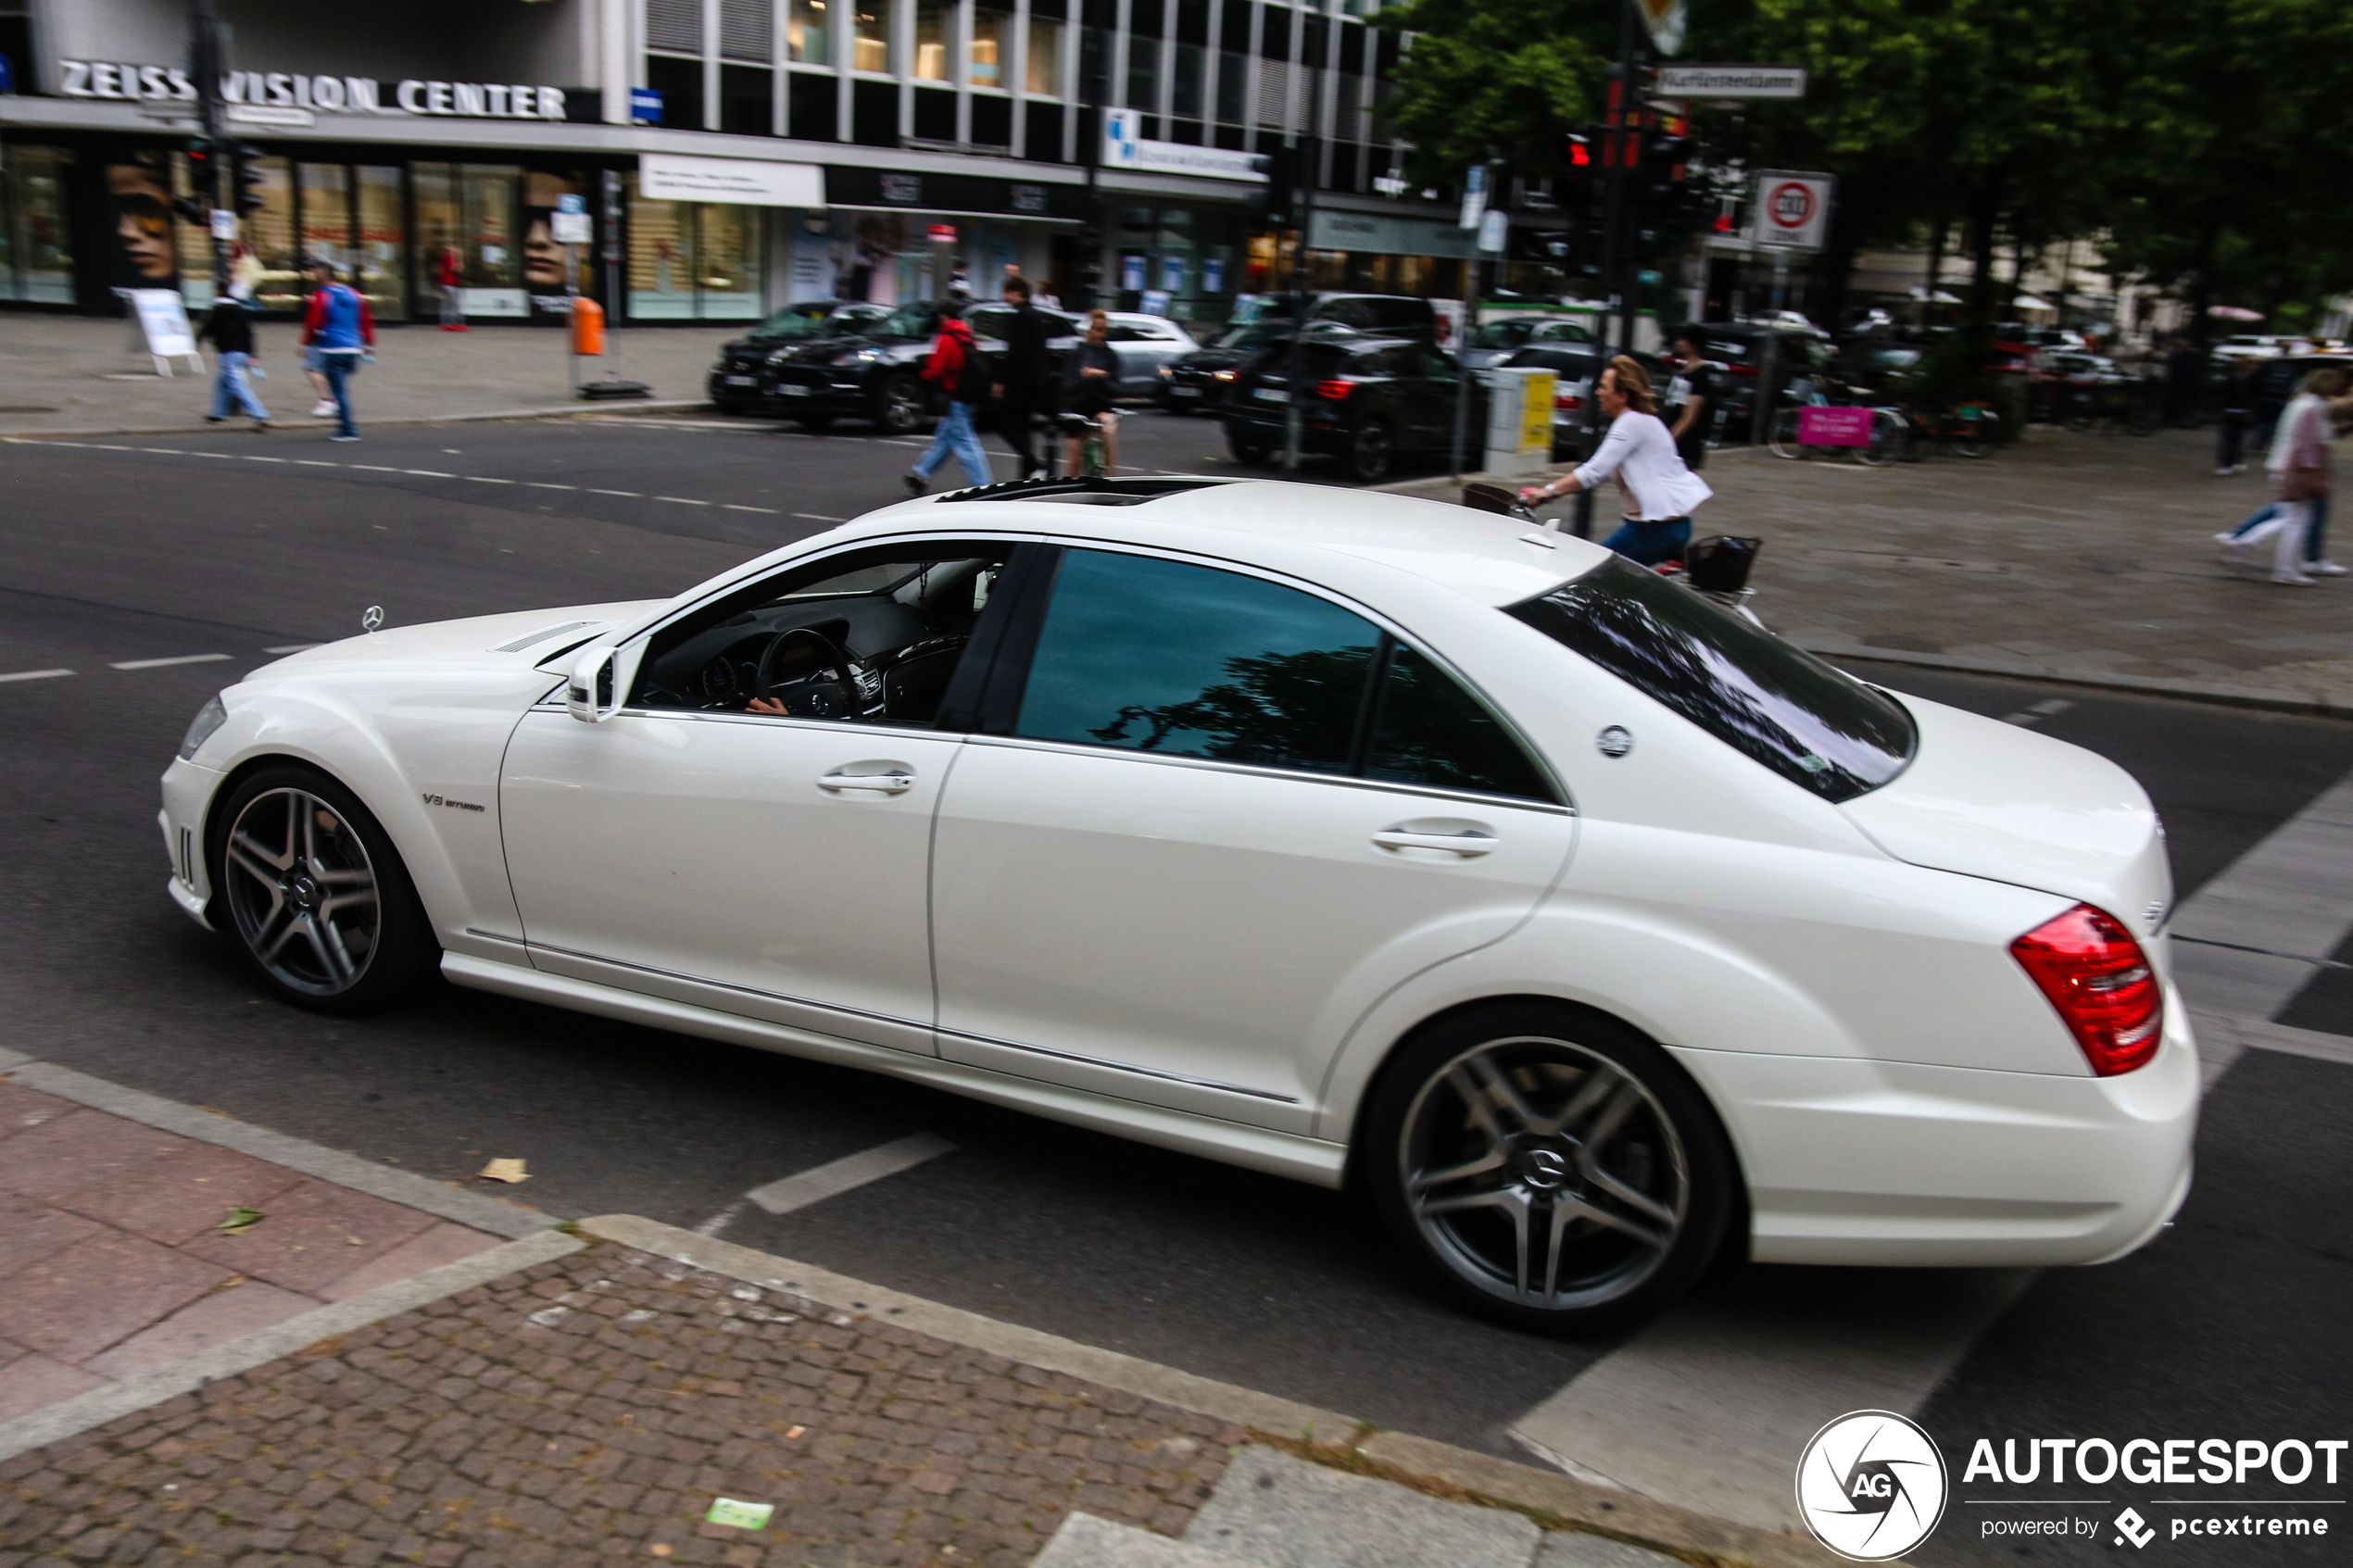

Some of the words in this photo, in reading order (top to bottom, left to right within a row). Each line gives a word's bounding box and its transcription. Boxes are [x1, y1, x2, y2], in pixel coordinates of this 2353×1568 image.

[59, 59, 198, 100] ZEISS
[220, 70, 379, 112] VISION
[396, 80, 567, 119] CENTER
[422, 793, 444, 806] V8
